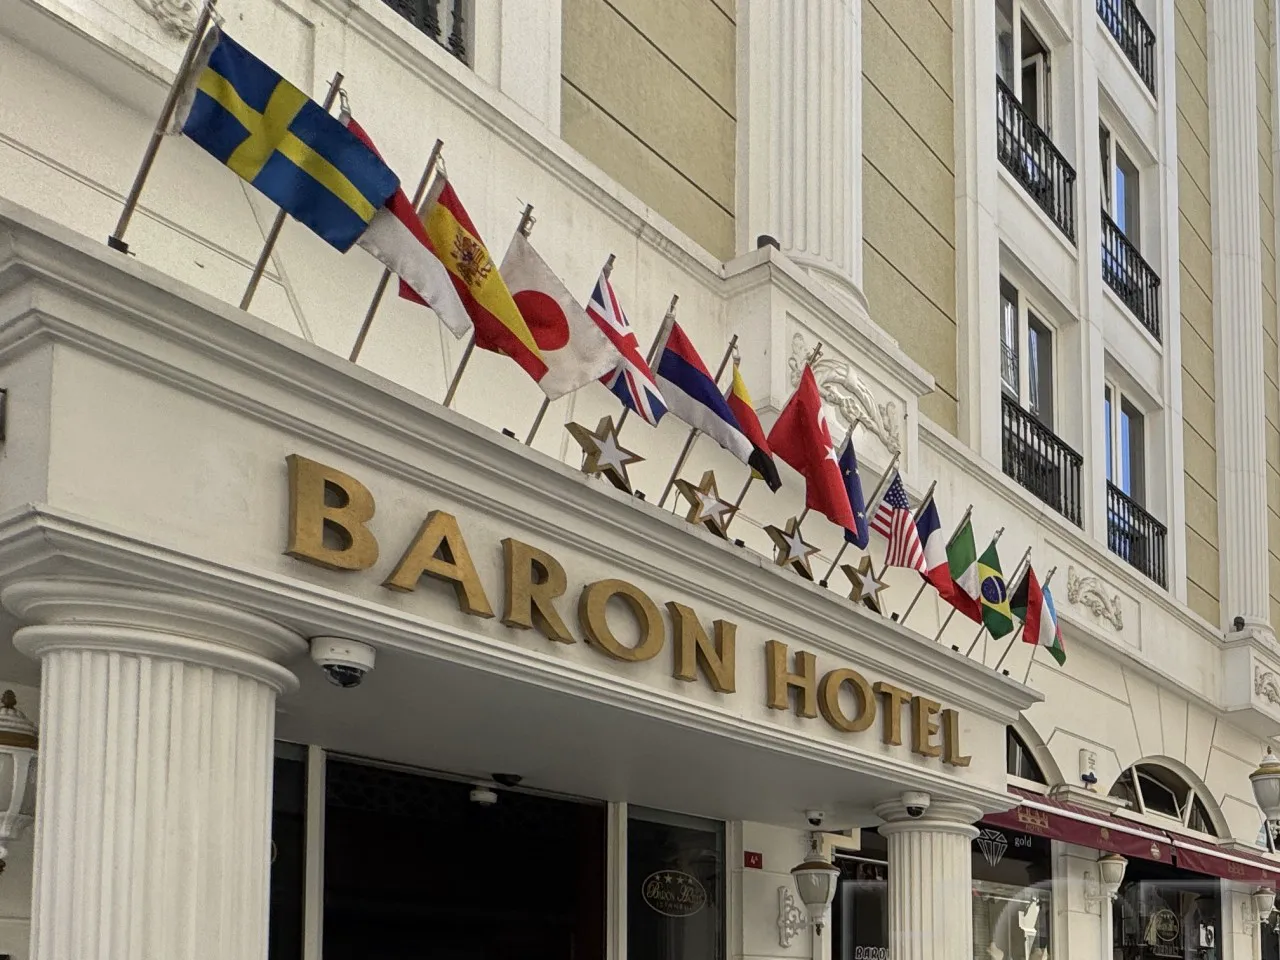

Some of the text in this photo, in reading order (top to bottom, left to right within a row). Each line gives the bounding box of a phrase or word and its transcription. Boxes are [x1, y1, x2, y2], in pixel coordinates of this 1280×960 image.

[283, 453, 972, 767] BARON HOTEL
[1014, 835, 1032, 848] gold
